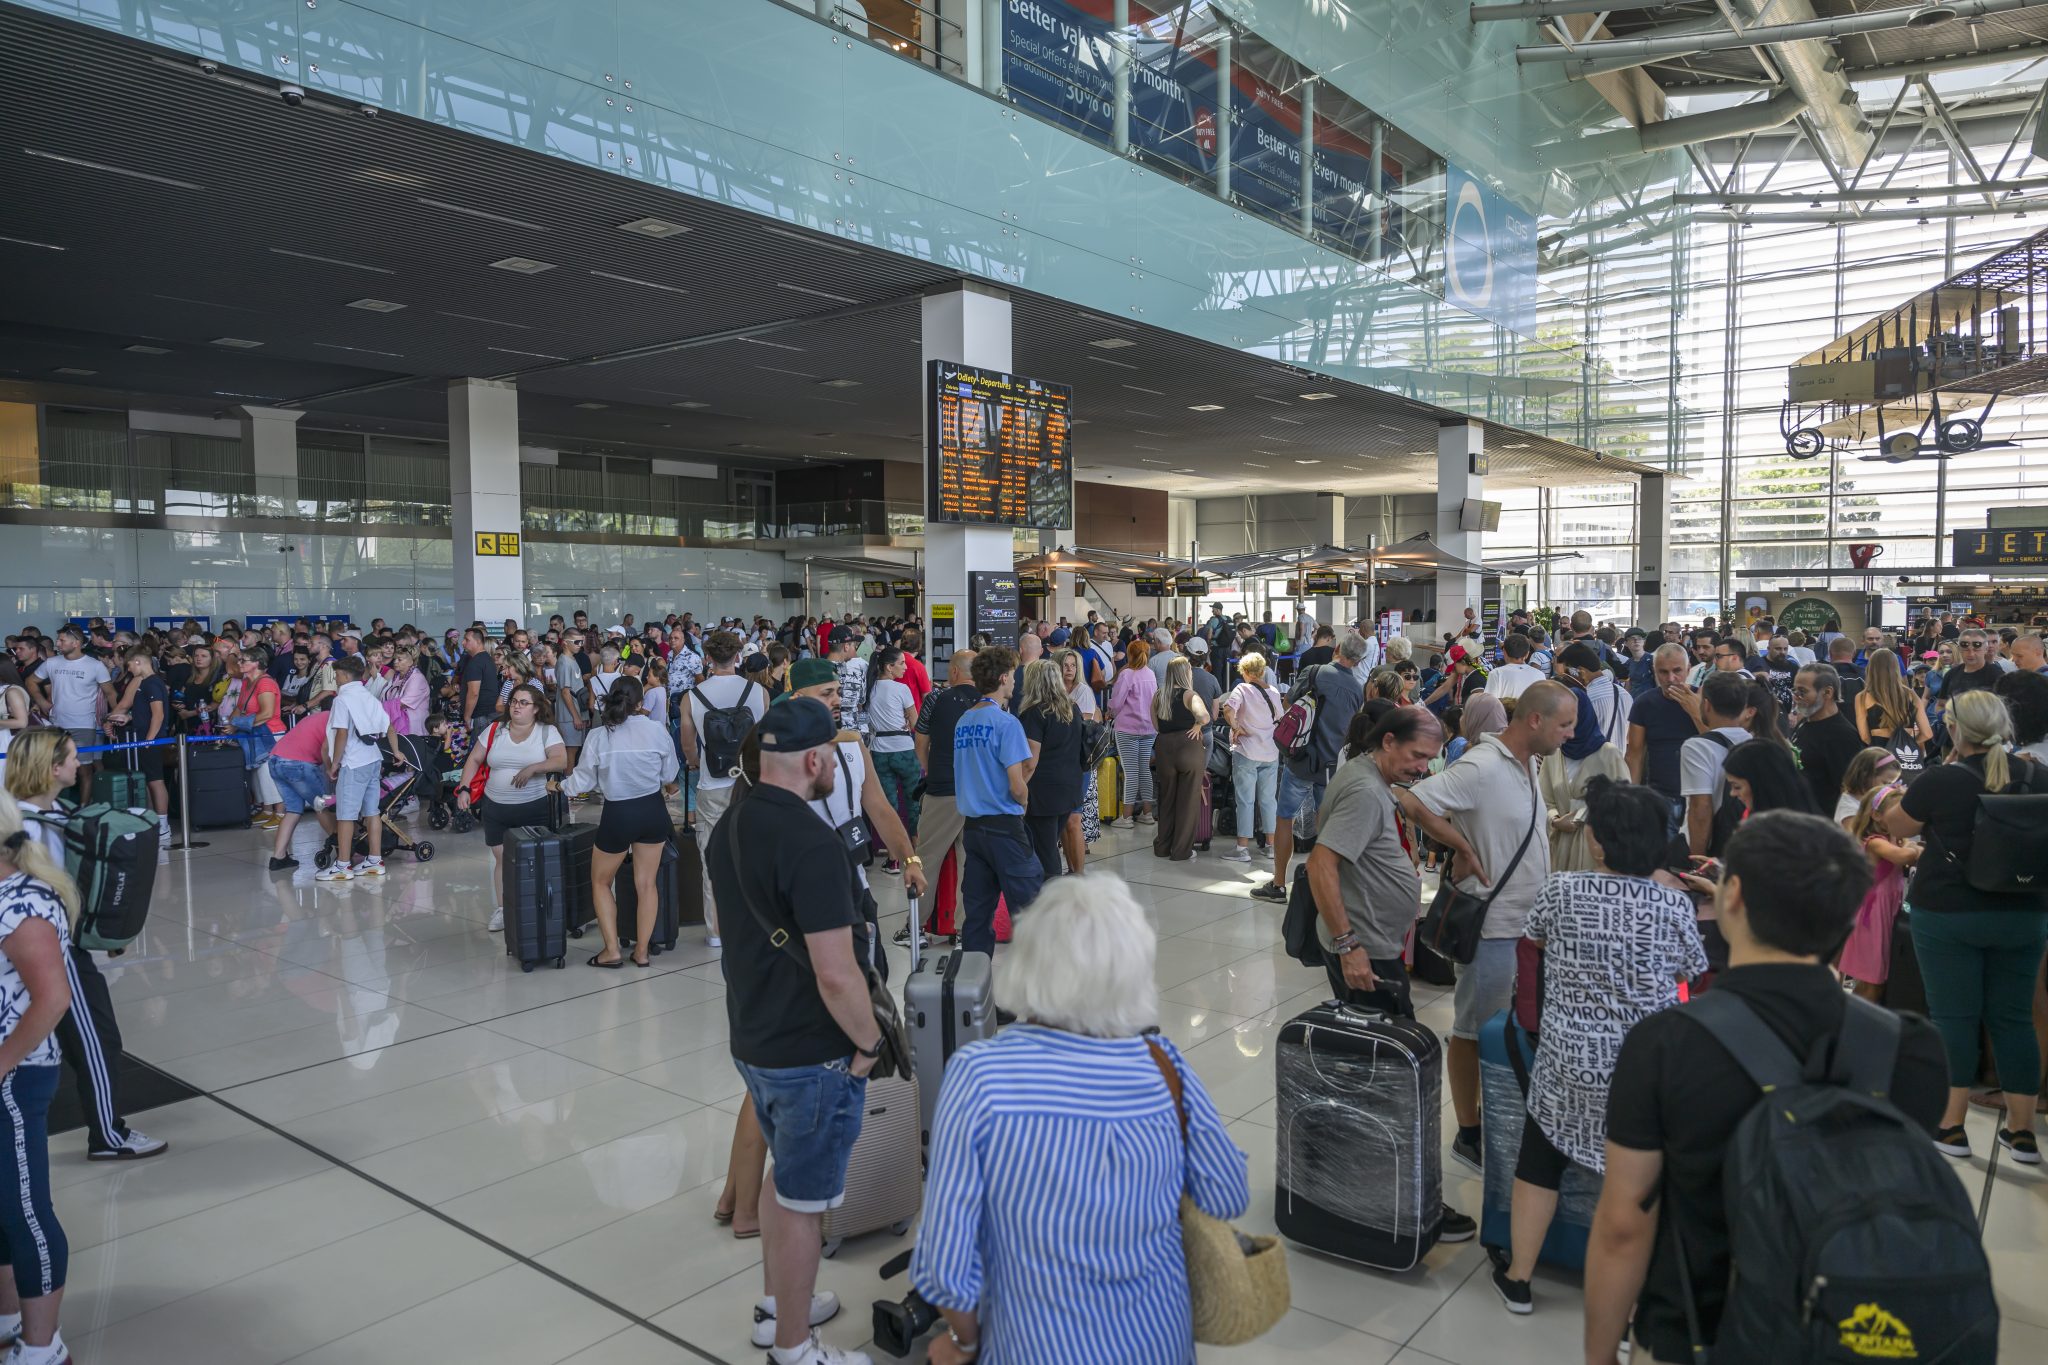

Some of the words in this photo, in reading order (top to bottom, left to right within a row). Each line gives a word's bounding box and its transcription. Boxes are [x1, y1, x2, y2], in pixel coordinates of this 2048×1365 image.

[1009, 0, 1056, 34] Better
[1142, 67, 1184, 103] month.
[1010, 30, 1040, 55] Special
[1042, 46, 1067, 68] Offers
[1068, 62, 1091, 84] every
[1065, 77, 1098, 112] 30%
[1257, 128, 1286, 157] Better
[1314, 166, 1338, 188] every
[1506, 214, 1528, 240] IQOS
[980, 377, 1012, 390] Departures
[1975, 532, 2046, 554] JET
[113, 872, 126, 905] FORCLAZ
[1562, 880, 1571, 914] ENERGY
[1573, 894, 1620, 906] RESOURCE
[1623, 901, 1634, 933] SPORT
[1636, 901, 1654, 910] LIFE
[1612, 908, 1620, 932] FOOD
[1581, 931, 1623, 943] HUMAN
[1635, 912, 1654, 991] VITAMINS
[1560, 968, 1611, 983] DOCTOR
[1580, 963, 1609, 971] NATURE
[1612, 946, 1627, 998] MEDICAL
[1652, 954, 1667, 999] DOCTOR
[1562, 989, 1613, 1006] HEART
[1562, 1031, 1585, 1040] GOOD
[1567, 1020, 1618, 1034] MEDICAL
[1588, 1036, 1598, 1069] HEART
[1609, 1036, 1620, 1059] DIET
[1561, 1055, 1584, 1068] LIFE
[1582, 1120, 1591, 1150] ENERG
[1576, 1150, 1597, 1160] VITAL
[1840, 1332, 1914, 1350] MONTANA
